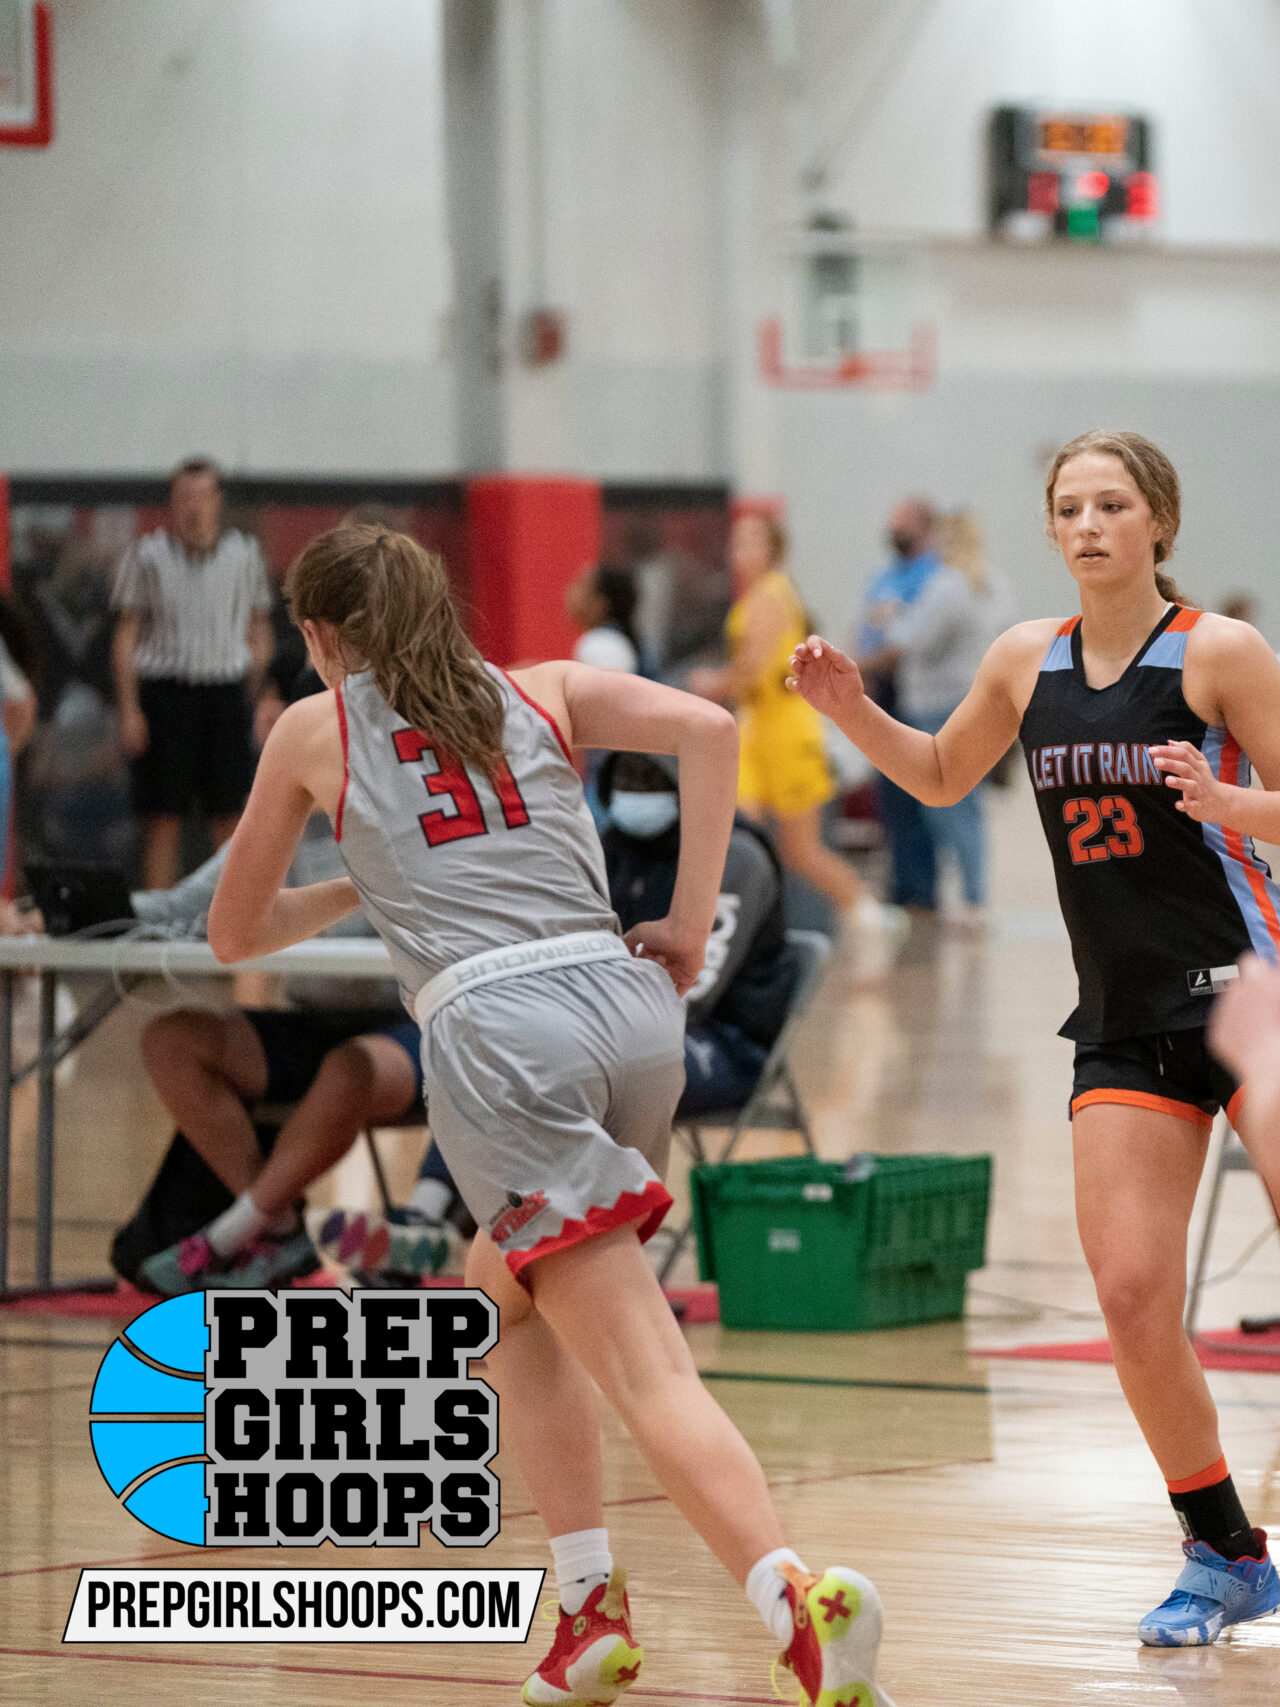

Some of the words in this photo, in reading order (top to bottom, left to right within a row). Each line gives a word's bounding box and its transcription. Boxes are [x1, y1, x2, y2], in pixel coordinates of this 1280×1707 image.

[392, 727, 531, 848] 31
[1032, 745, 1068, 791] LET
[1072, 743, 1095, 784] IT
[1098, 742, 1162, 785] RAIN
[1063, 795, 1144, 866] 23
